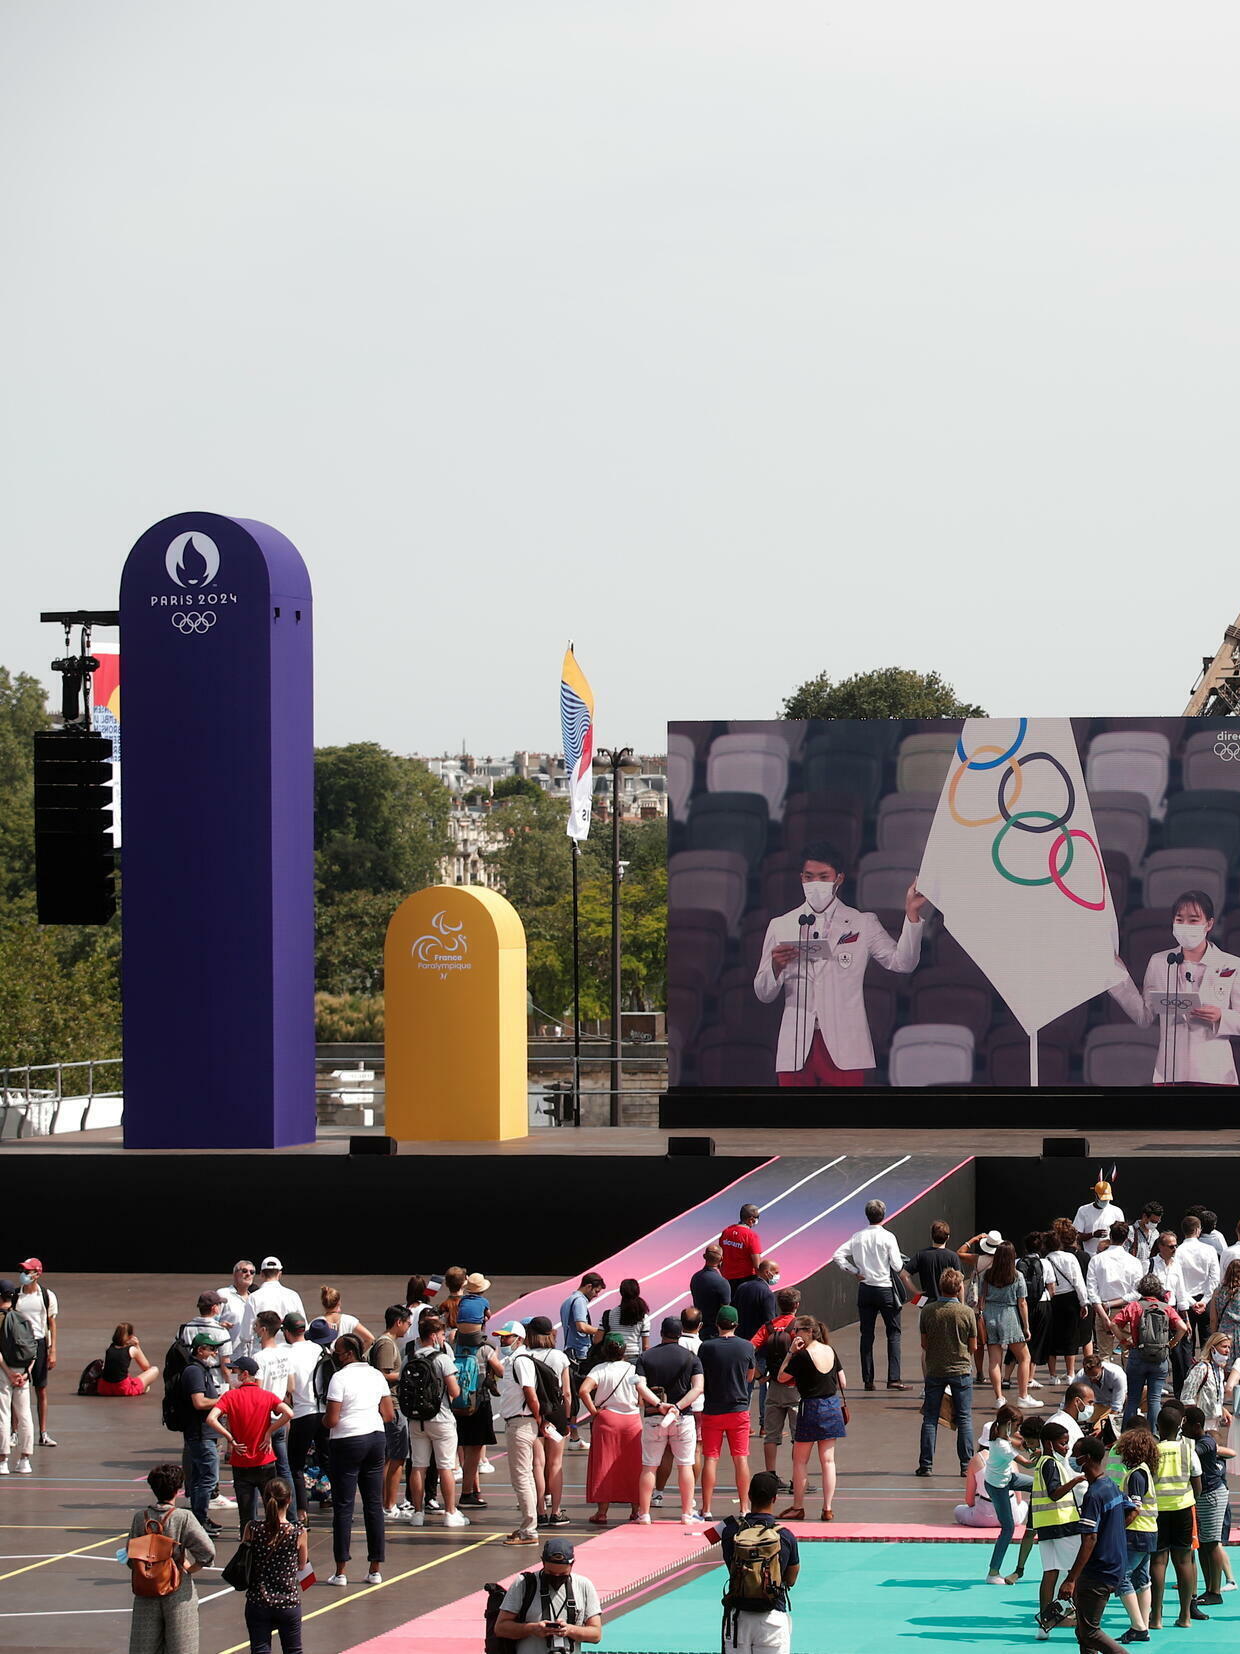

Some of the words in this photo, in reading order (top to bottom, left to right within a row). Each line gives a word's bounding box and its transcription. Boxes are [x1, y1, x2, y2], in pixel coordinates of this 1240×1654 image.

[151, 595, 193, 606] PARIS
[198, 593, 237, 605] 2024
[417, 963, 472, 971] Paralympique
